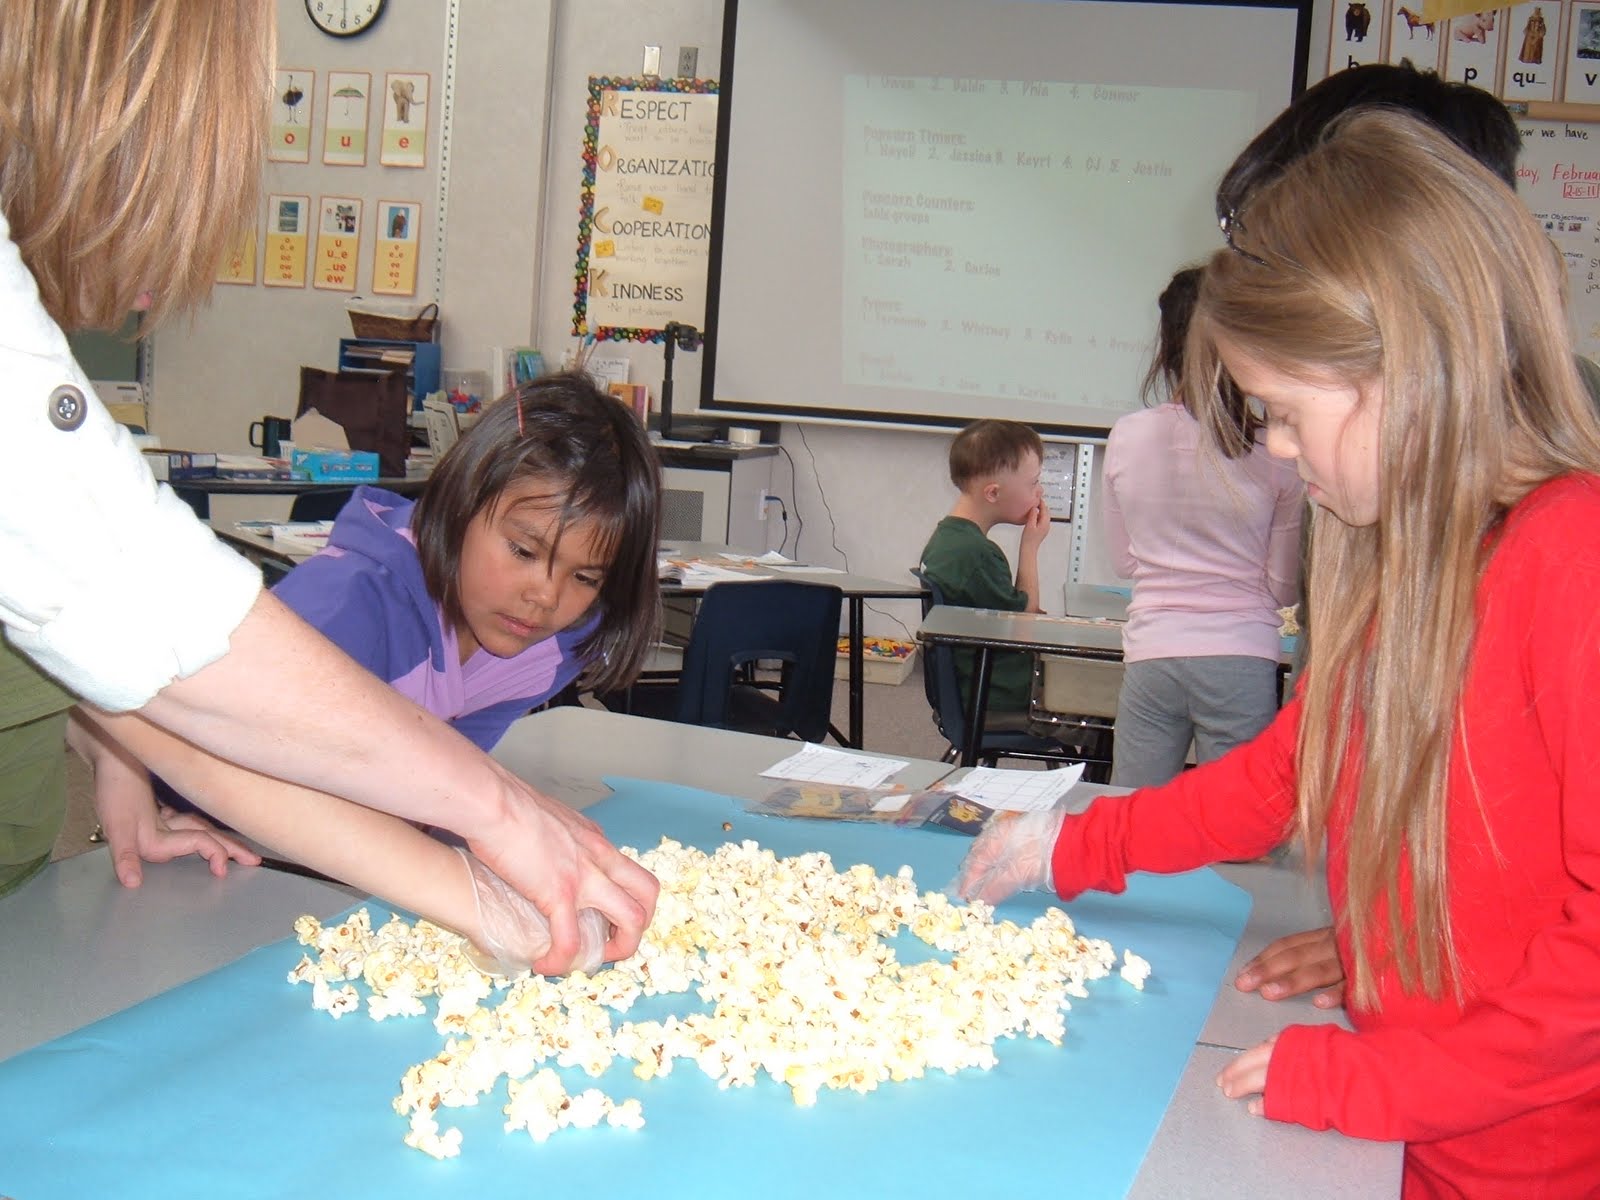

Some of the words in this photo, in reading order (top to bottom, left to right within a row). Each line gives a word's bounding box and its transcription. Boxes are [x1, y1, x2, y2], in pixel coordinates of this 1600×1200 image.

[317, 2, 323, 11] 8
[367, 5, 372, 13] 4
[327, 14, 333, 23] 7
[340, 19, 346, 29] 6
[354, 15, 361, 25] 5
[1465, 67, 1478, 84] p
[600, 90, 692, 122] RESPECT
[1541, 129, 1556, 138] we
[1564, 123, 1588, 140] have
[284, 133, 296, 145] o
[341, 135, 351, 148] u
[398, 137, 410, 149] e
[588, 268, 683, 301] KINDNESS
